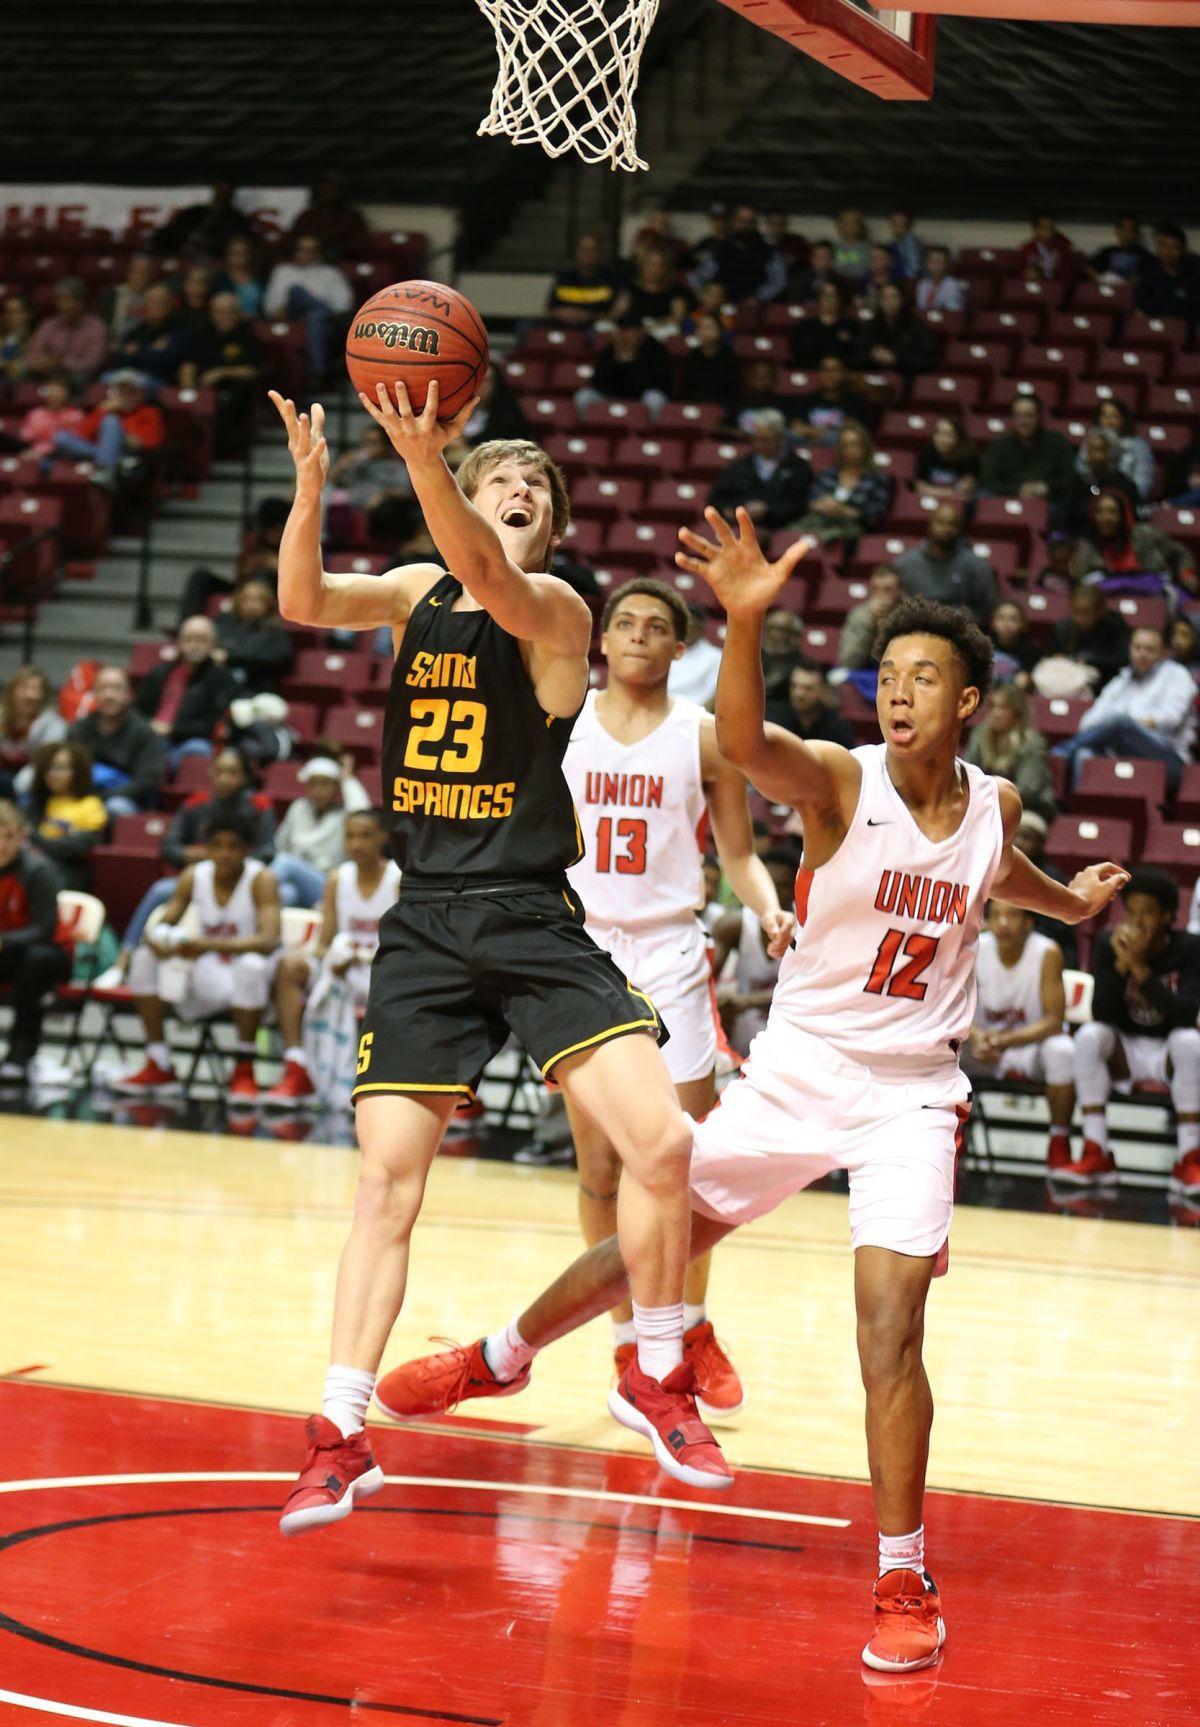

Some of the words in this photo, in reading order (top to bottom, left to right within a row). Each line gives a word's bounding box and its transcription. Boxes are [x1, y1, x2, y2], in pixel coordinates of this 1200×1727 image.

[354, 320, 440, 357] Wilson
[403, 698, 488, 773] 23
[392, 776, 516, 820] SPRINGS
[585, 770, 664, 808] UNION
[596, 816, 648, 875] 13
[873, 868, 970, 925] UNION
[862, 927, 941, 1001] 12
[356, 1031, 374, 1076] S
